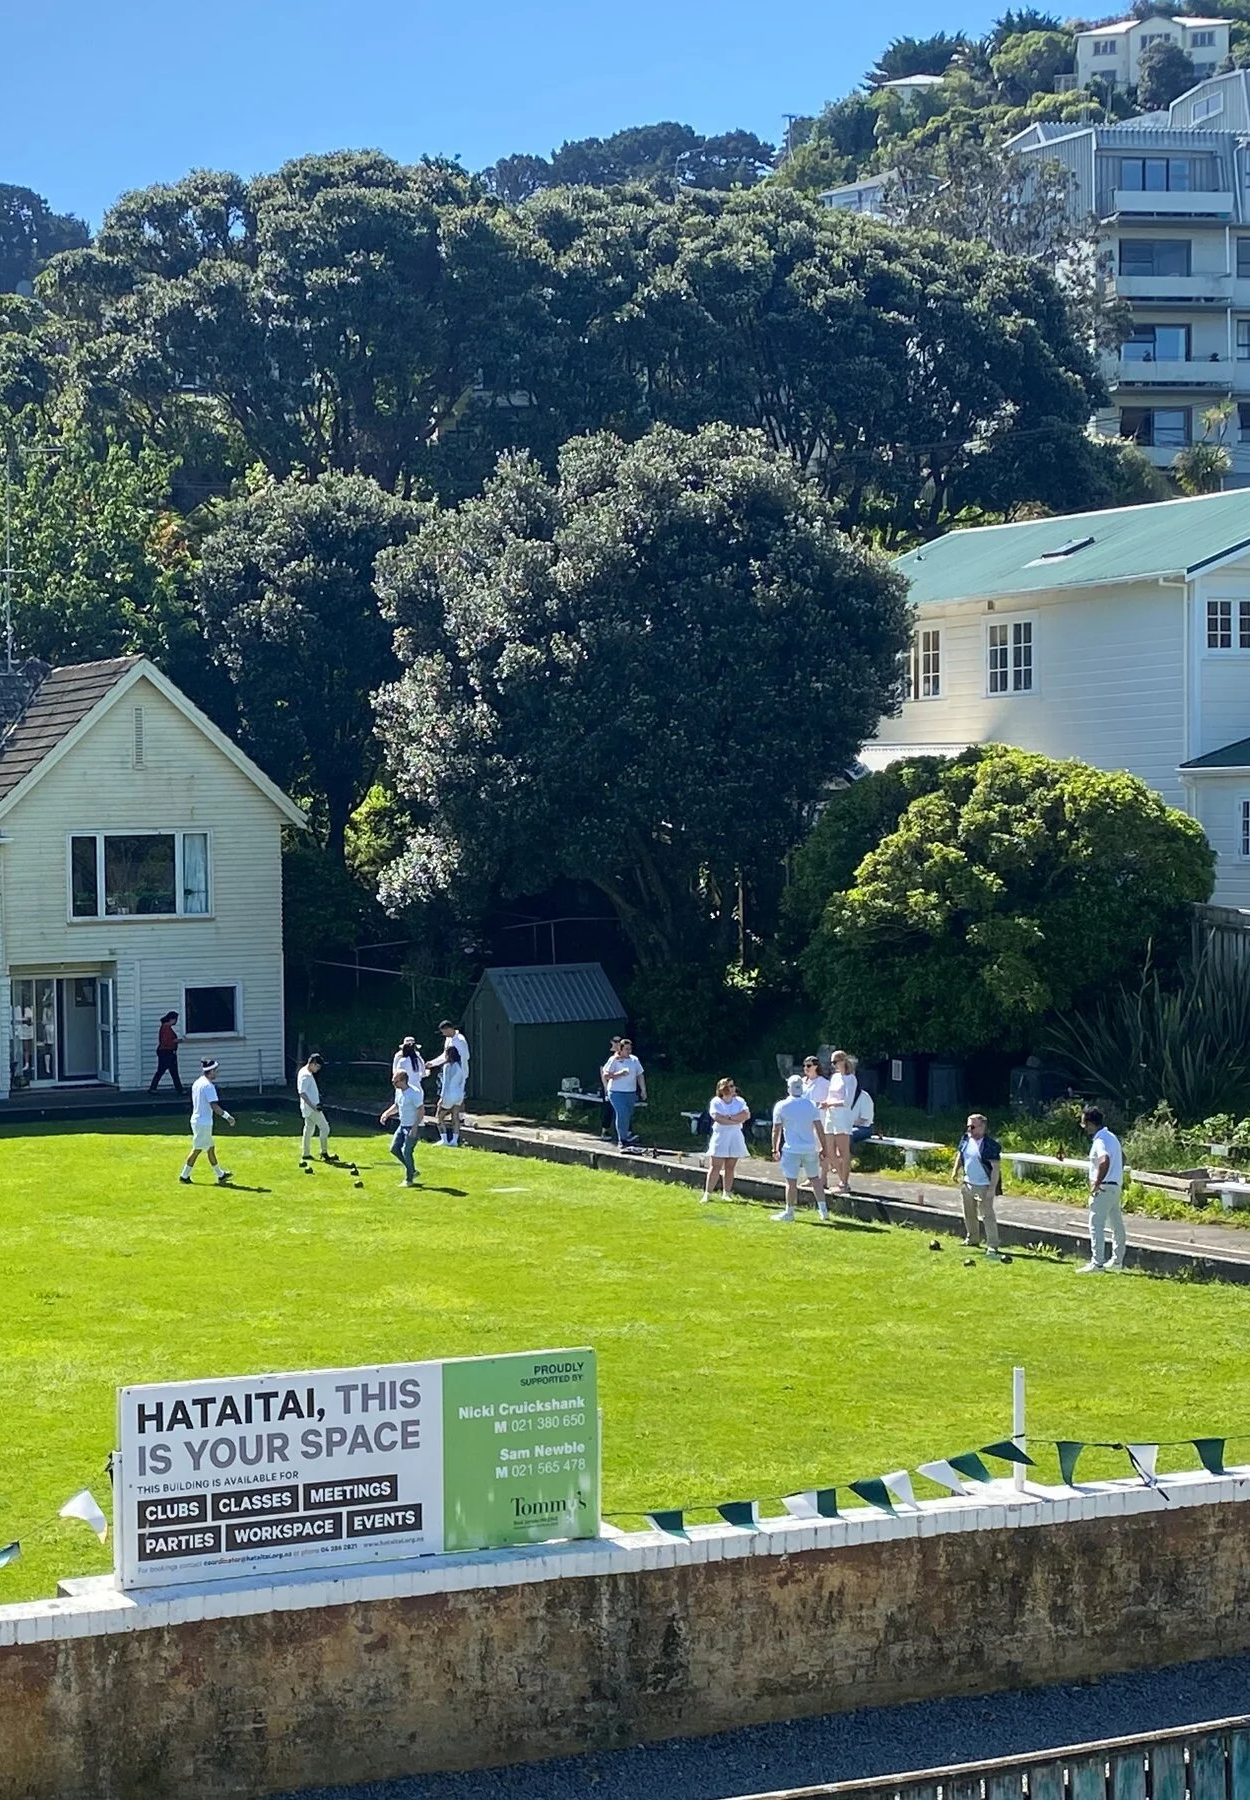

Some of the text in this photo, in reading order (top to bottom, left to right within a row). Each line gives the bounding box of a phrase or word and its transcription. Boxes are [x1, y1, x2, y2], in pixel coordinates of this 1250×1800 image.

[534, 1362, 584, 1375] PROUDLY
[520, 1375, 570, 1386] SUPPORTED
[137, 1379, 421, 1434] HATAITAI, THIS
[459, 1396, 585, 1419] Nicki Cruickshank
[494, 1413, 585, 1433] M 021 380 650
[138, 1419, 420, 1476] IS YOUR SPACE
[500, 1441, 585, 1460] Sam Newble
[495, 1458, 585, 1479] M 021 565 478
[137, 1471, 299, 1494] THIS BUILDING IS AVAILABLE FOR
[145, 1481, 391, 1520] CLUBS CLASSES MEETINGS
[145, 1510, 415, 1553] PARTIES WORKSPACE EVENTS
